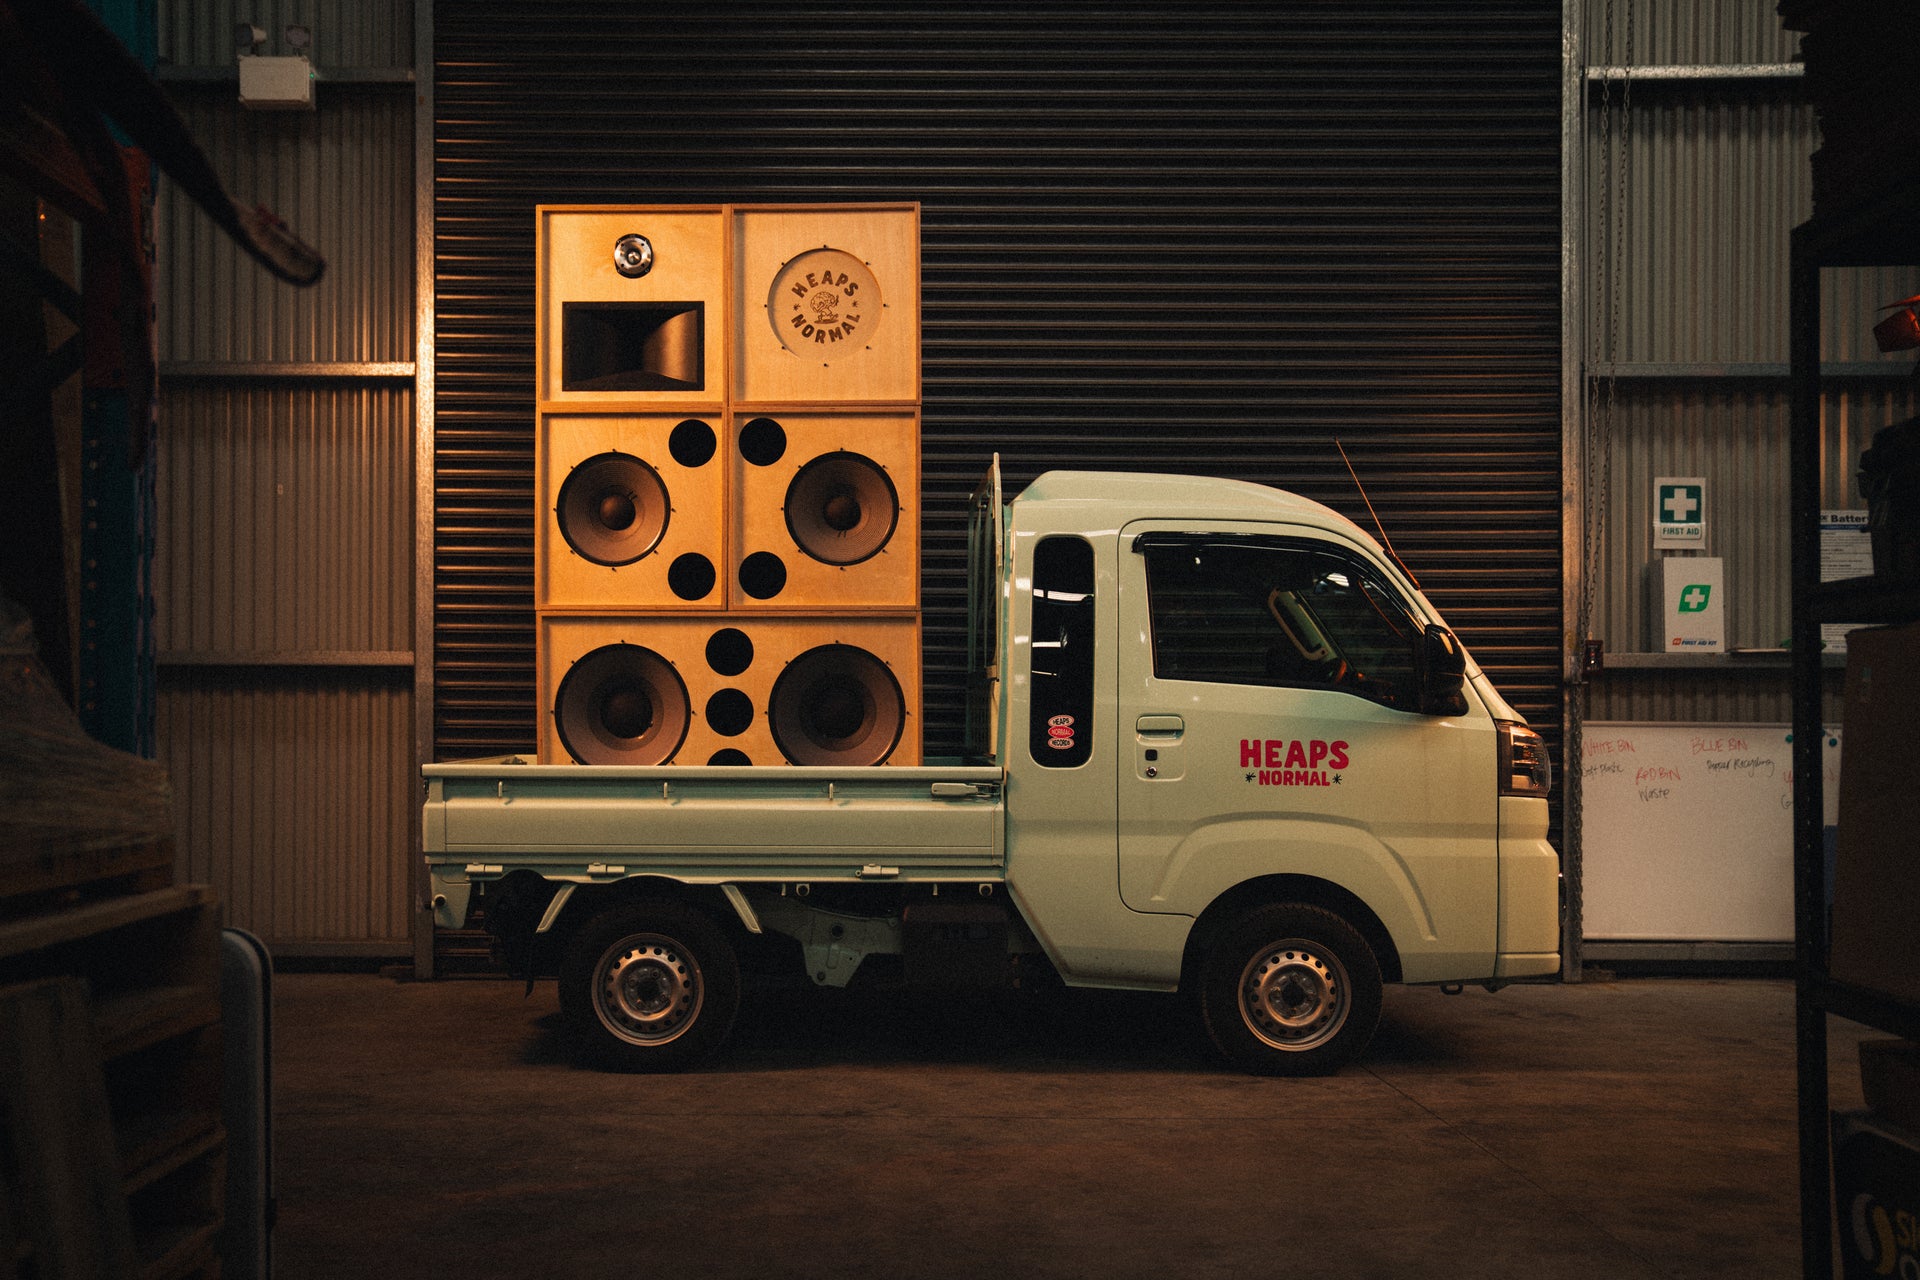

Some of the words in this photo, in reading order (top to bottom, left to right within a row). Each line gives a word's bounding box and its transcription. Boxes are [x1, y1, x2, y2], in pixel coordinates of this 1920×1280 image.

[791, 270, 859, 298] HEAPS
[791, 313, 861, 344] NORMAL
[1831, 514, 1869, 523] Batter
[1662, 527, 1684, 535] FIRST
[1686, 527, 1700, 535] AID
[1053, 717, 1070, 726] HEAPS
[1240, 739, 1349, 770] HEAPS
[1690, 737, 1723, 755] BLUE
[1728, 738, 1748, 752] BIN
[1258, 770, 1331, 787] NORMAL
